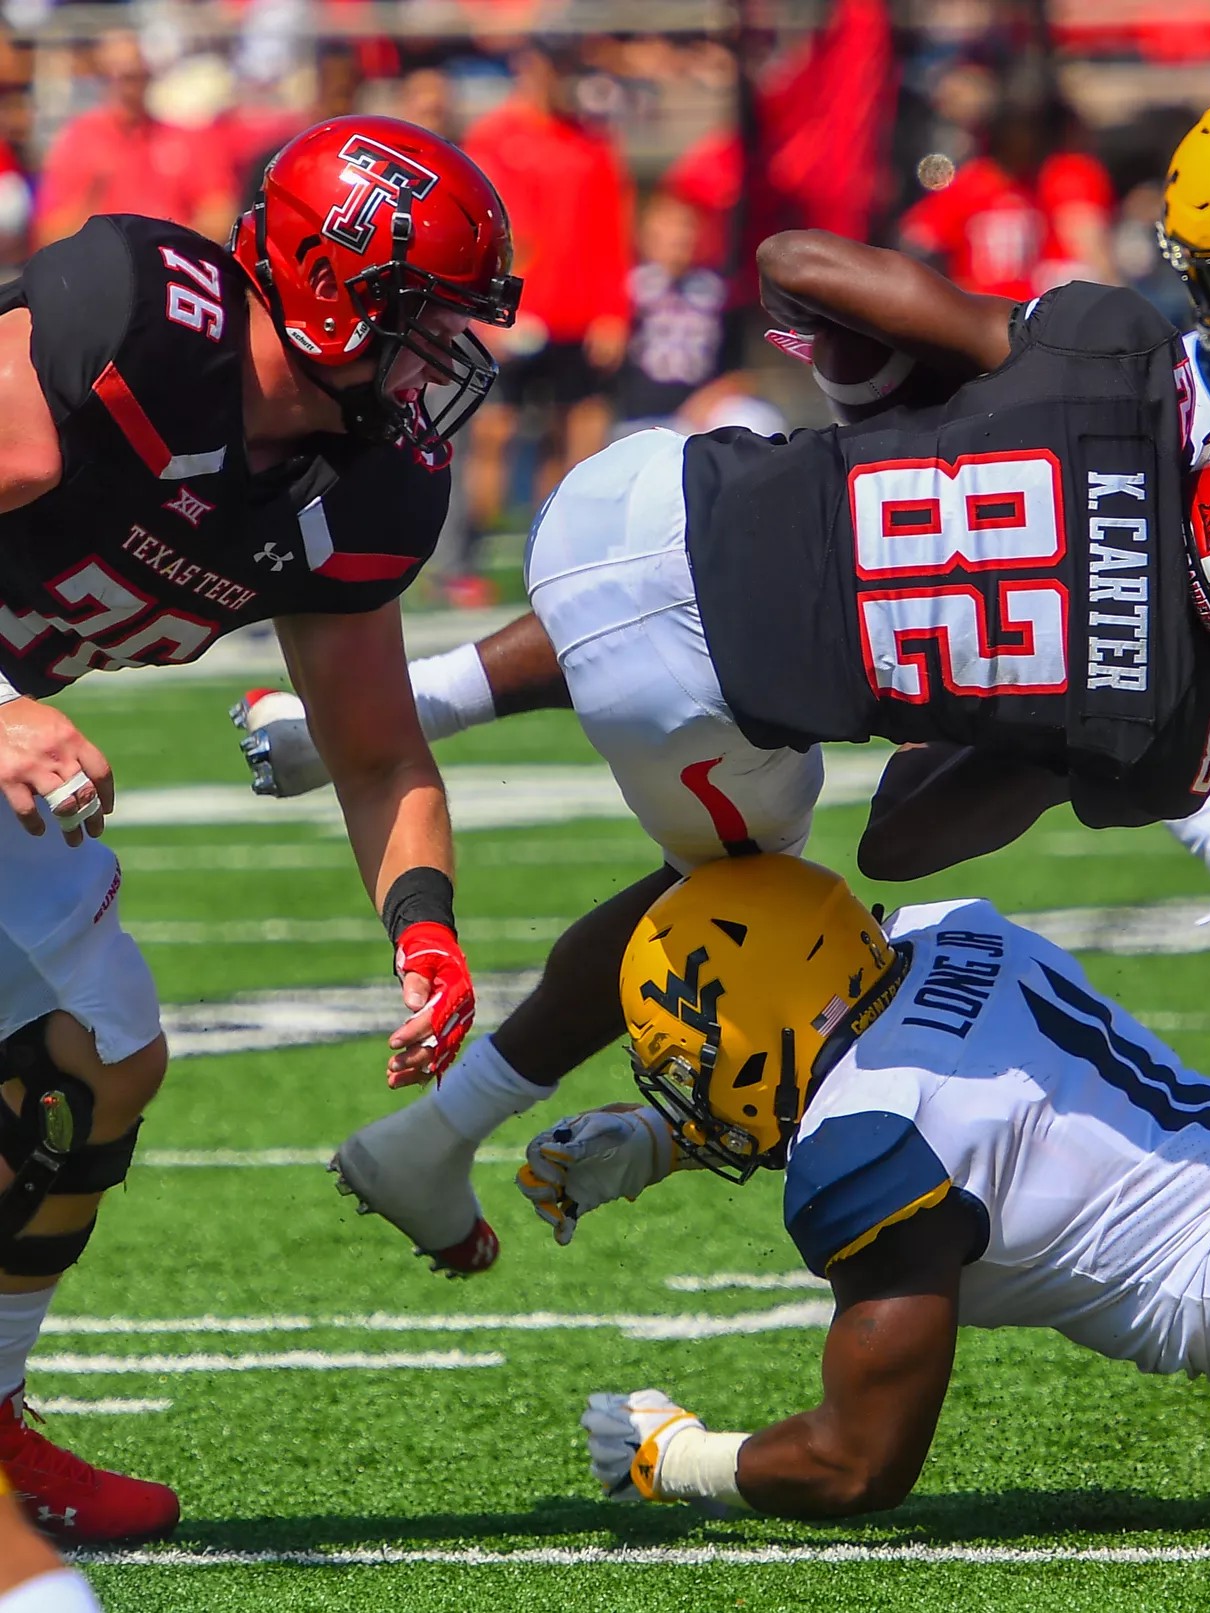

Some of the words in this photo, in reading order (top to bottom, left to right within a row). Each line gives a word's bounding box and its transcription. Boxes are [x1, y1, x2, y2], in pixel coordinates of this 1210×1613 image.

[158, 245, 224, 343] 76
[290, 329, 316, 352] schutt
[121, 523, 201, 586] TEXAS
[193, 571, 257, 611] TECH
[847, 447, 1070, 705] 82
[936, 930, 1004, 959] JR
[850, 976, 902, 1036] CUNTRY
[902, 954, 1001, 1040] LONG
